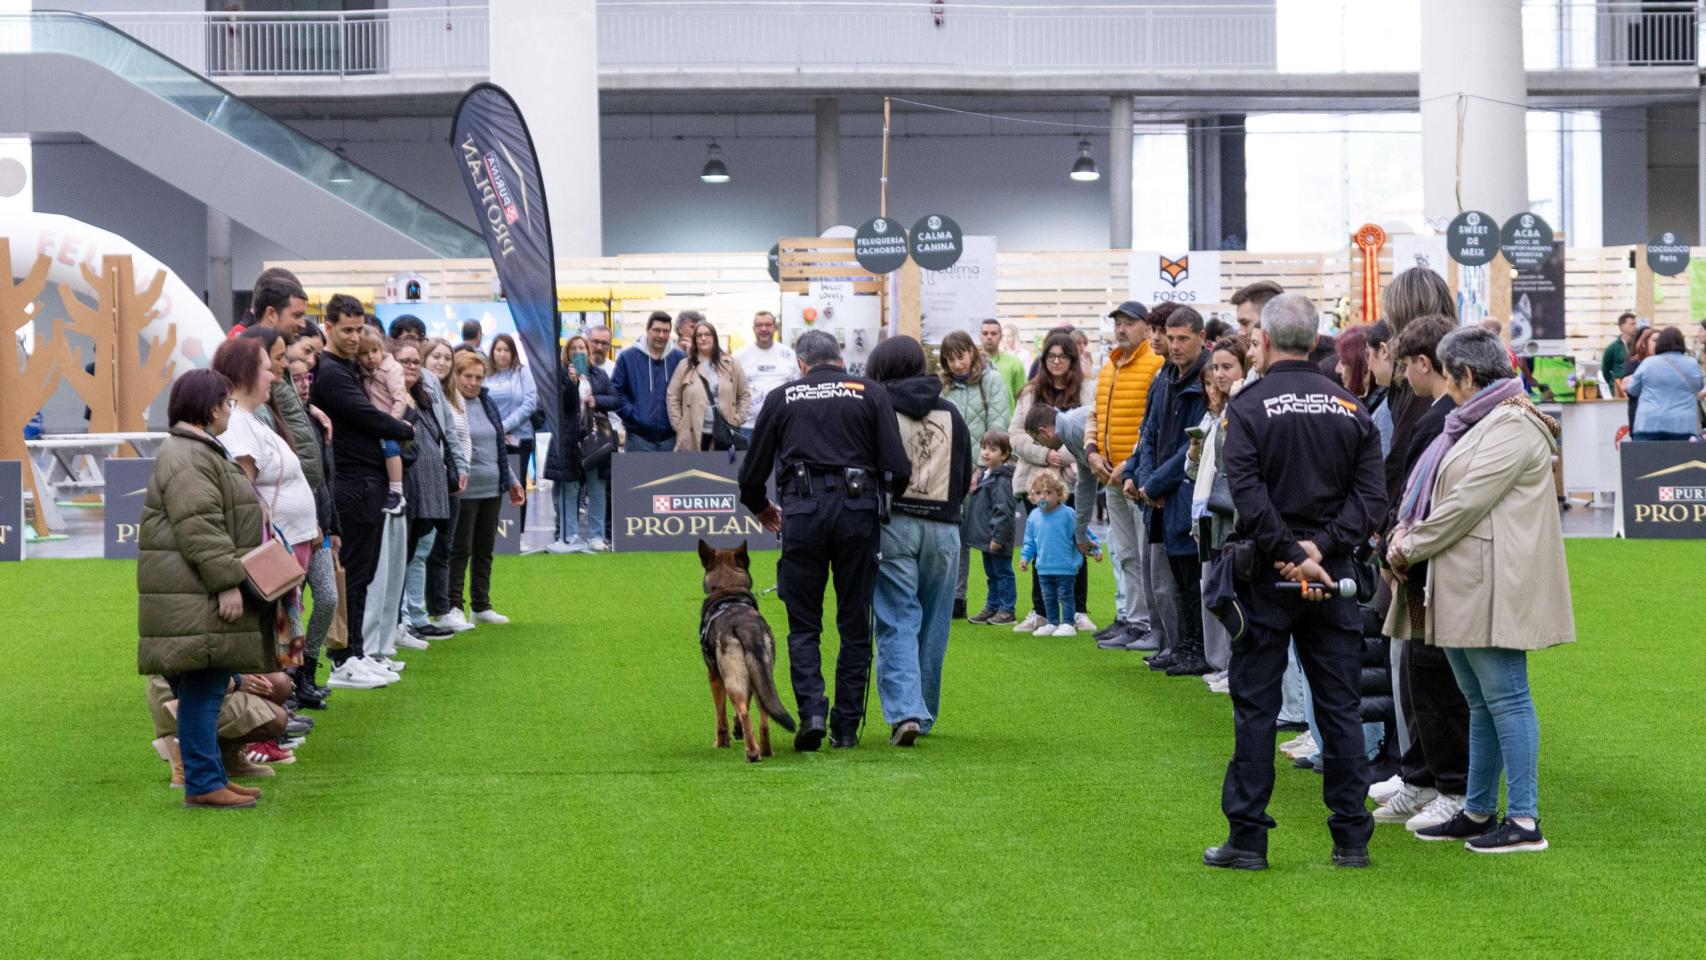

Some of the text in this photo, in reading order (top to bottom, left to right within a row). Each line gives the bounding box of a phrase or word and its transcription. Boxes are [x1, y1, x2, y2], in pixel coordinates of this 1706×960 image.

[917, 230, 953, 241] CALMA
[1458, 225, 1489, 235] SWEET
[1513, 229, 1541, 238] ACBA
[856, 235, 905, 246] PELUQUERÍA
[1466, 236, 1479, 246] DE
[856, 245, 907, 255] CACHORROS
[916, 242, 955, 252] CANINA
[1460, 248, 1486, 257] MEIX
[1647, 245, 1690, 253] COCOLOCO
[1153, 290, 1197, 302] FOFOS
[784, 381, 847, 396] POLICIA
[786, 388, 864, 405] NACIONAL
[1263, 393, 1341, 409] POLICIA
[1266, 403, 1356, 418] NACIONAL
[672, 497, 732, 510] PURINA
[1634, 503, 1689, 522] PRO
[625, 515, 763, 536] PRO PLAN
